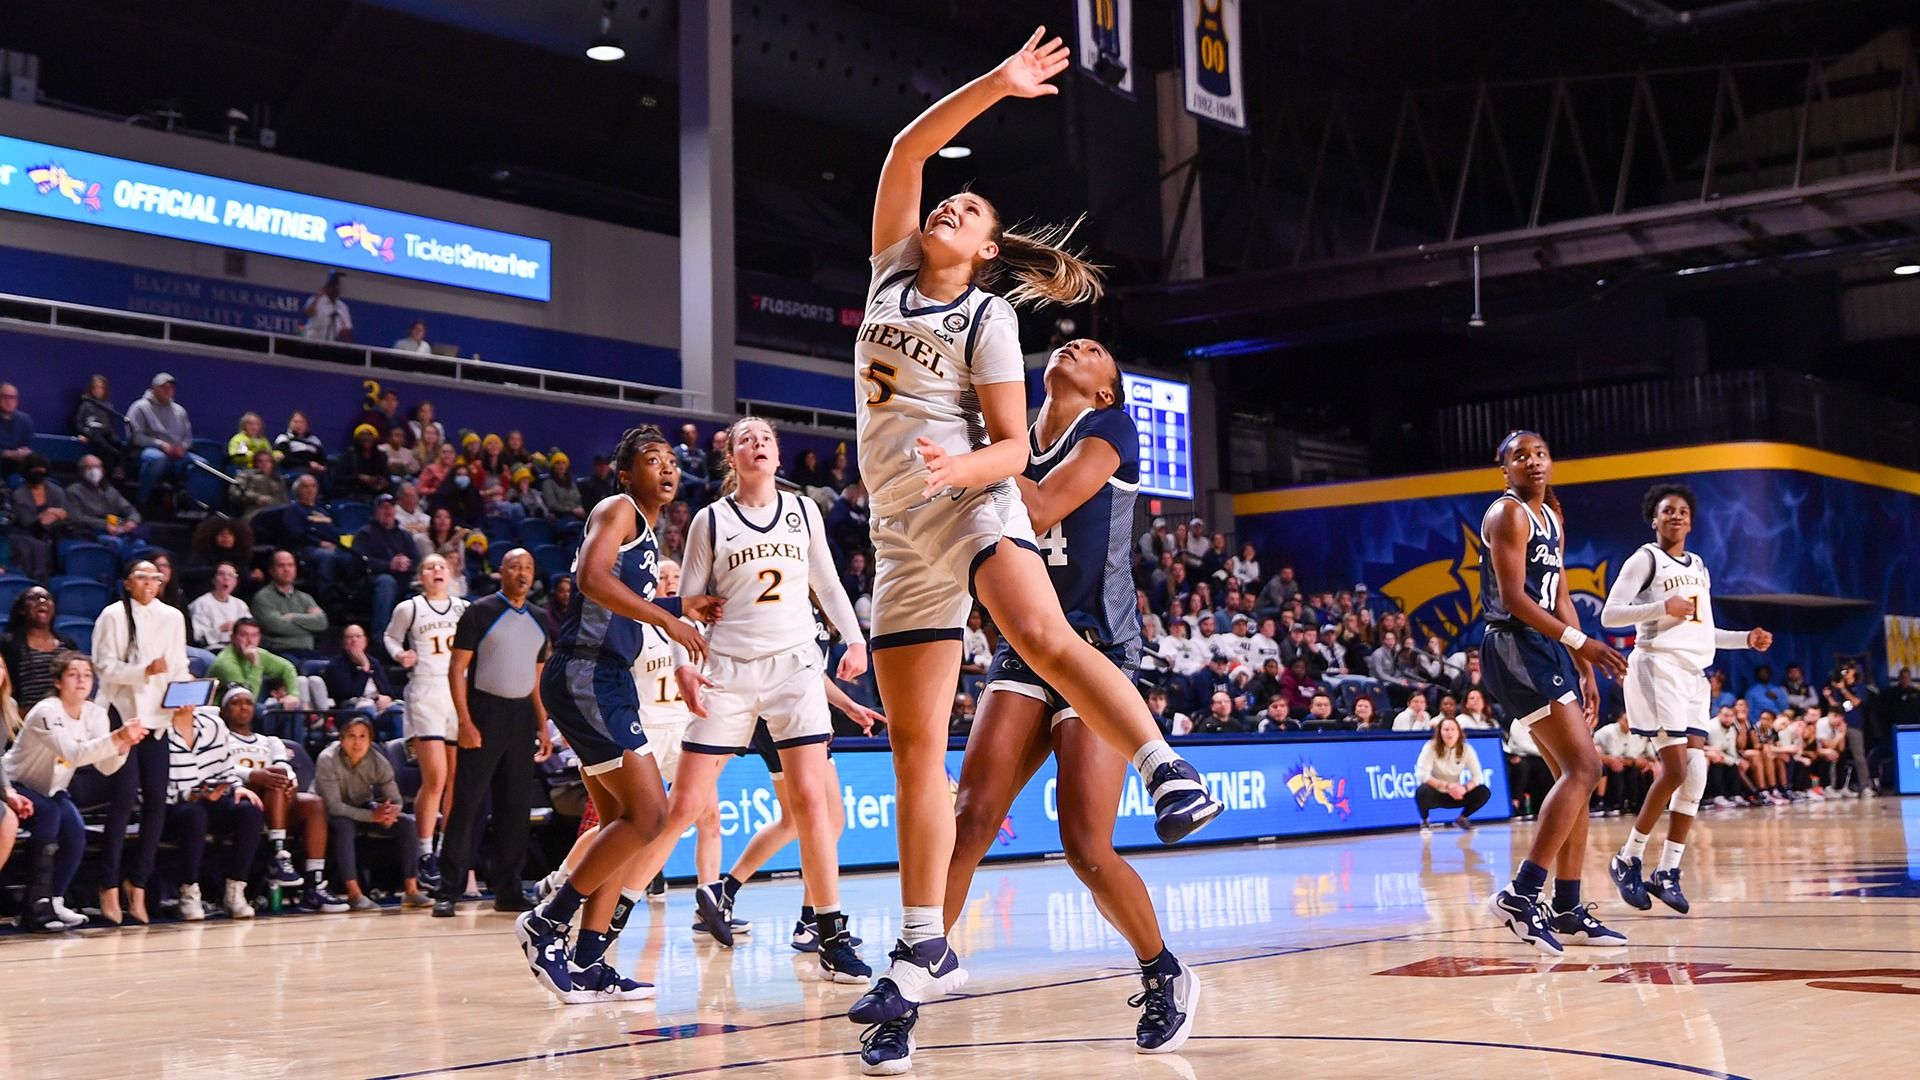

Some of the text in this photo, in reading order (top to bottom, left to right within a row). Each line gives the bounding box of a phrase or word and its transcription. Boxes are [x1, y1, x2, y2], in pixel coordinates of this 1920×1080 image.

[1201, 34, 1226, 74] 00
[113, 179, 328, 243] OFFICIAL PARTNER
[404, 232, 540, 279] TicketSmarter
[362, 379, 381, 411] 3
[866, 358, 898, 408] 5
[728, 542, 804, 572] DREXEL
[755, 567, 784, 604] 2
